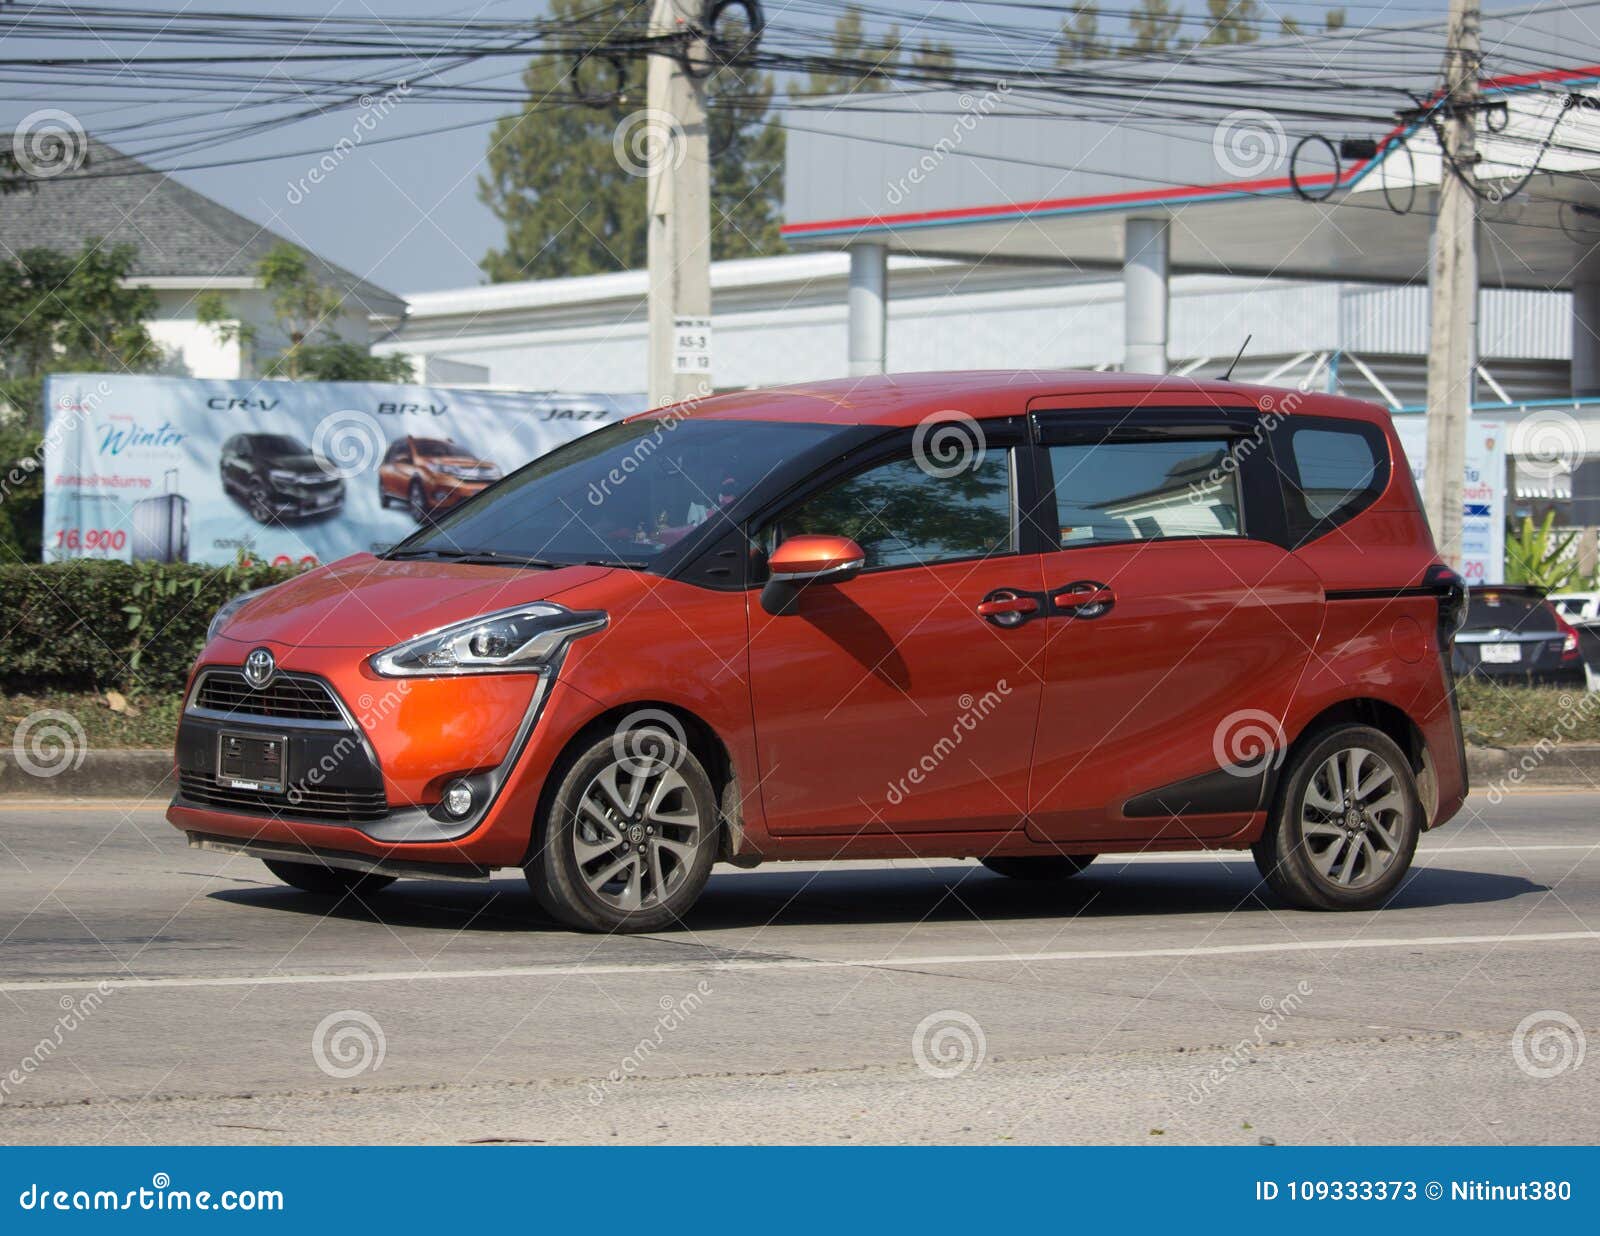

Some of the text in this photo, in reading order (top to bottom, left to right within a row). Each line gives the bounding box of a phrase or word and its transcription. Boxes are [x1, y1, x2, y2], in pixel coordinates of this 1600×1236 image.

[207, 398, 280, 411] CR-V
[377, 402, 448, 416] BR-V
[540, 408, 609, 421] JAZZ
[97, 421, 189, 456] Winter
